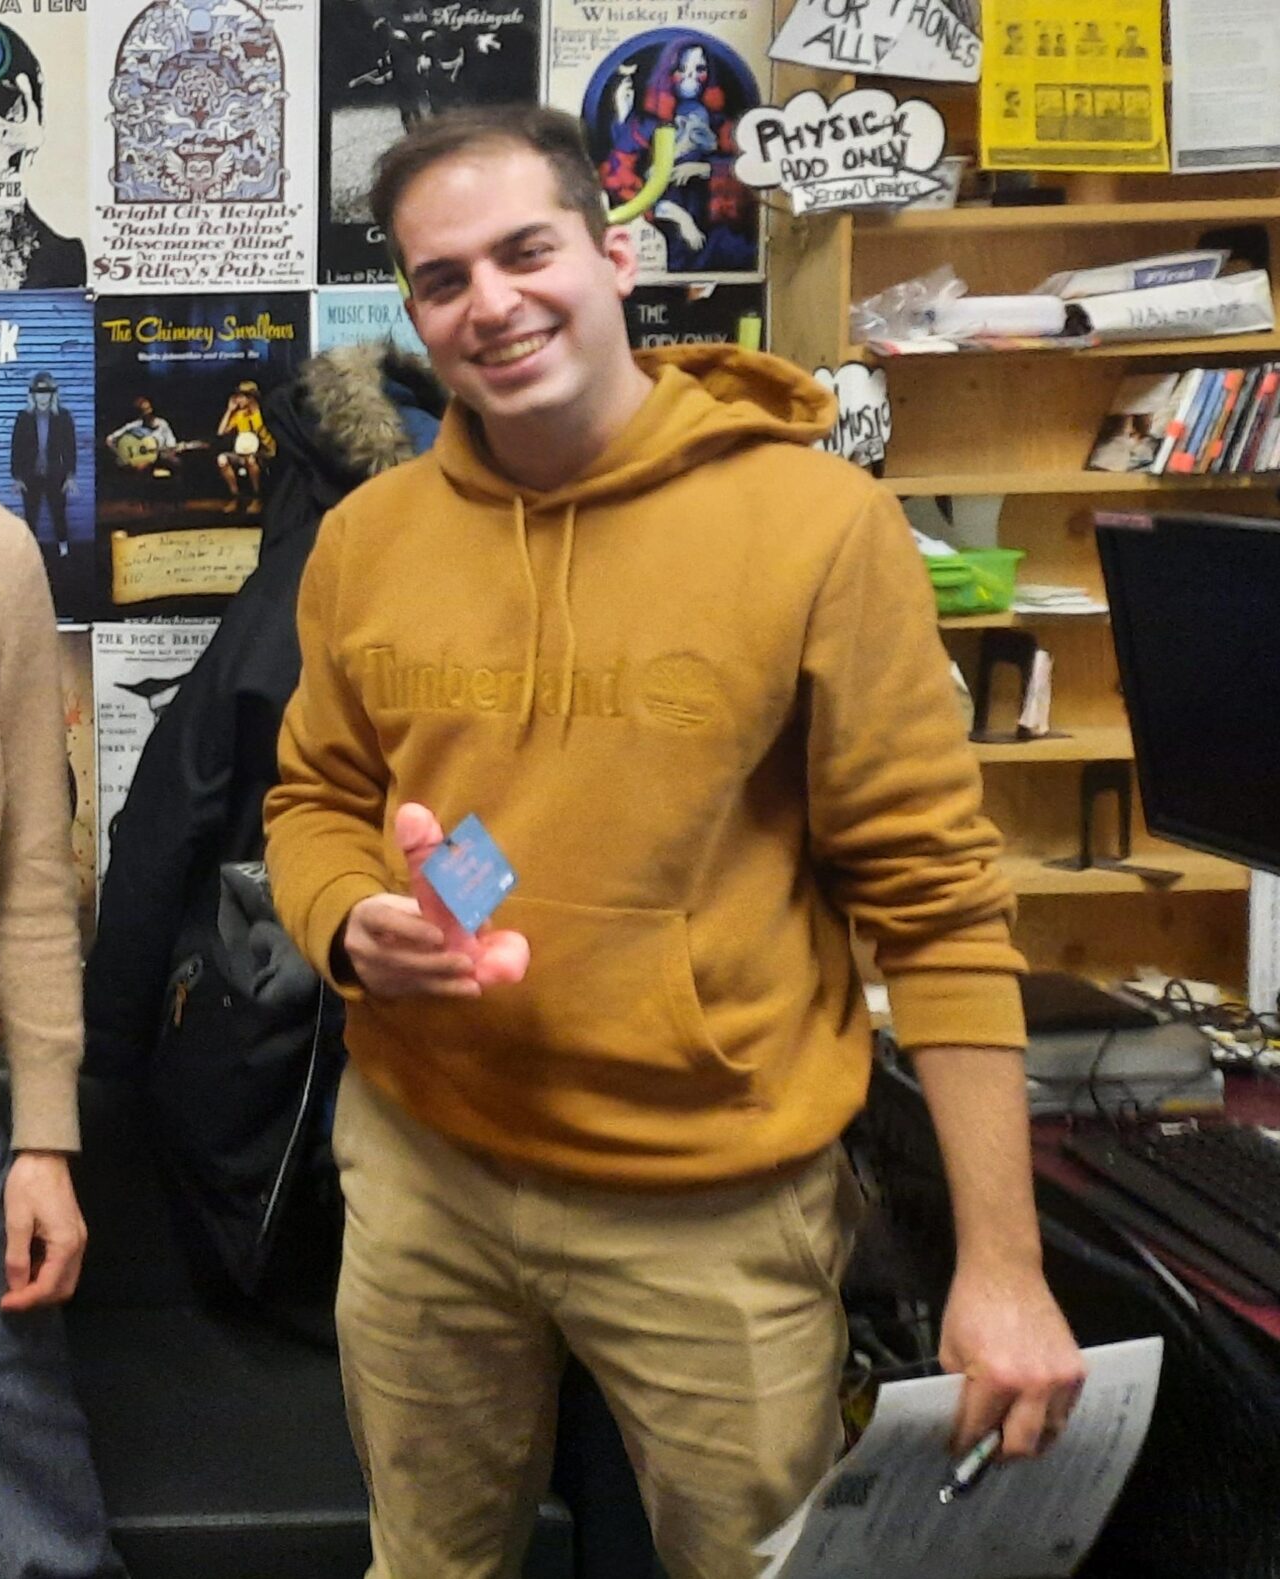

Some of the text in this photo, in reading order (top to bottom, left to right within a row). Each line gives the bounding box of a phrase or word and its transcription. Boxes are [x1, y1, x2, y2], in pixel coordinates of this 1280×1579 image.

[582, 4, 747, 23] Whiskey Fingers
[173, 205, 214, 221] City
[92, 254, 132, 281] $5
[136, 261, 209, 279] Riley's
[217, 261, 266, 279] Pub
[328, 304, 366, 325] MUSIC
[368, 304, 392, 324] FOR
[638, 303, 669, 325] THE
[101, 312, 294, 349] The Chimney Swallows
[97, 633, 124, 645] THE
